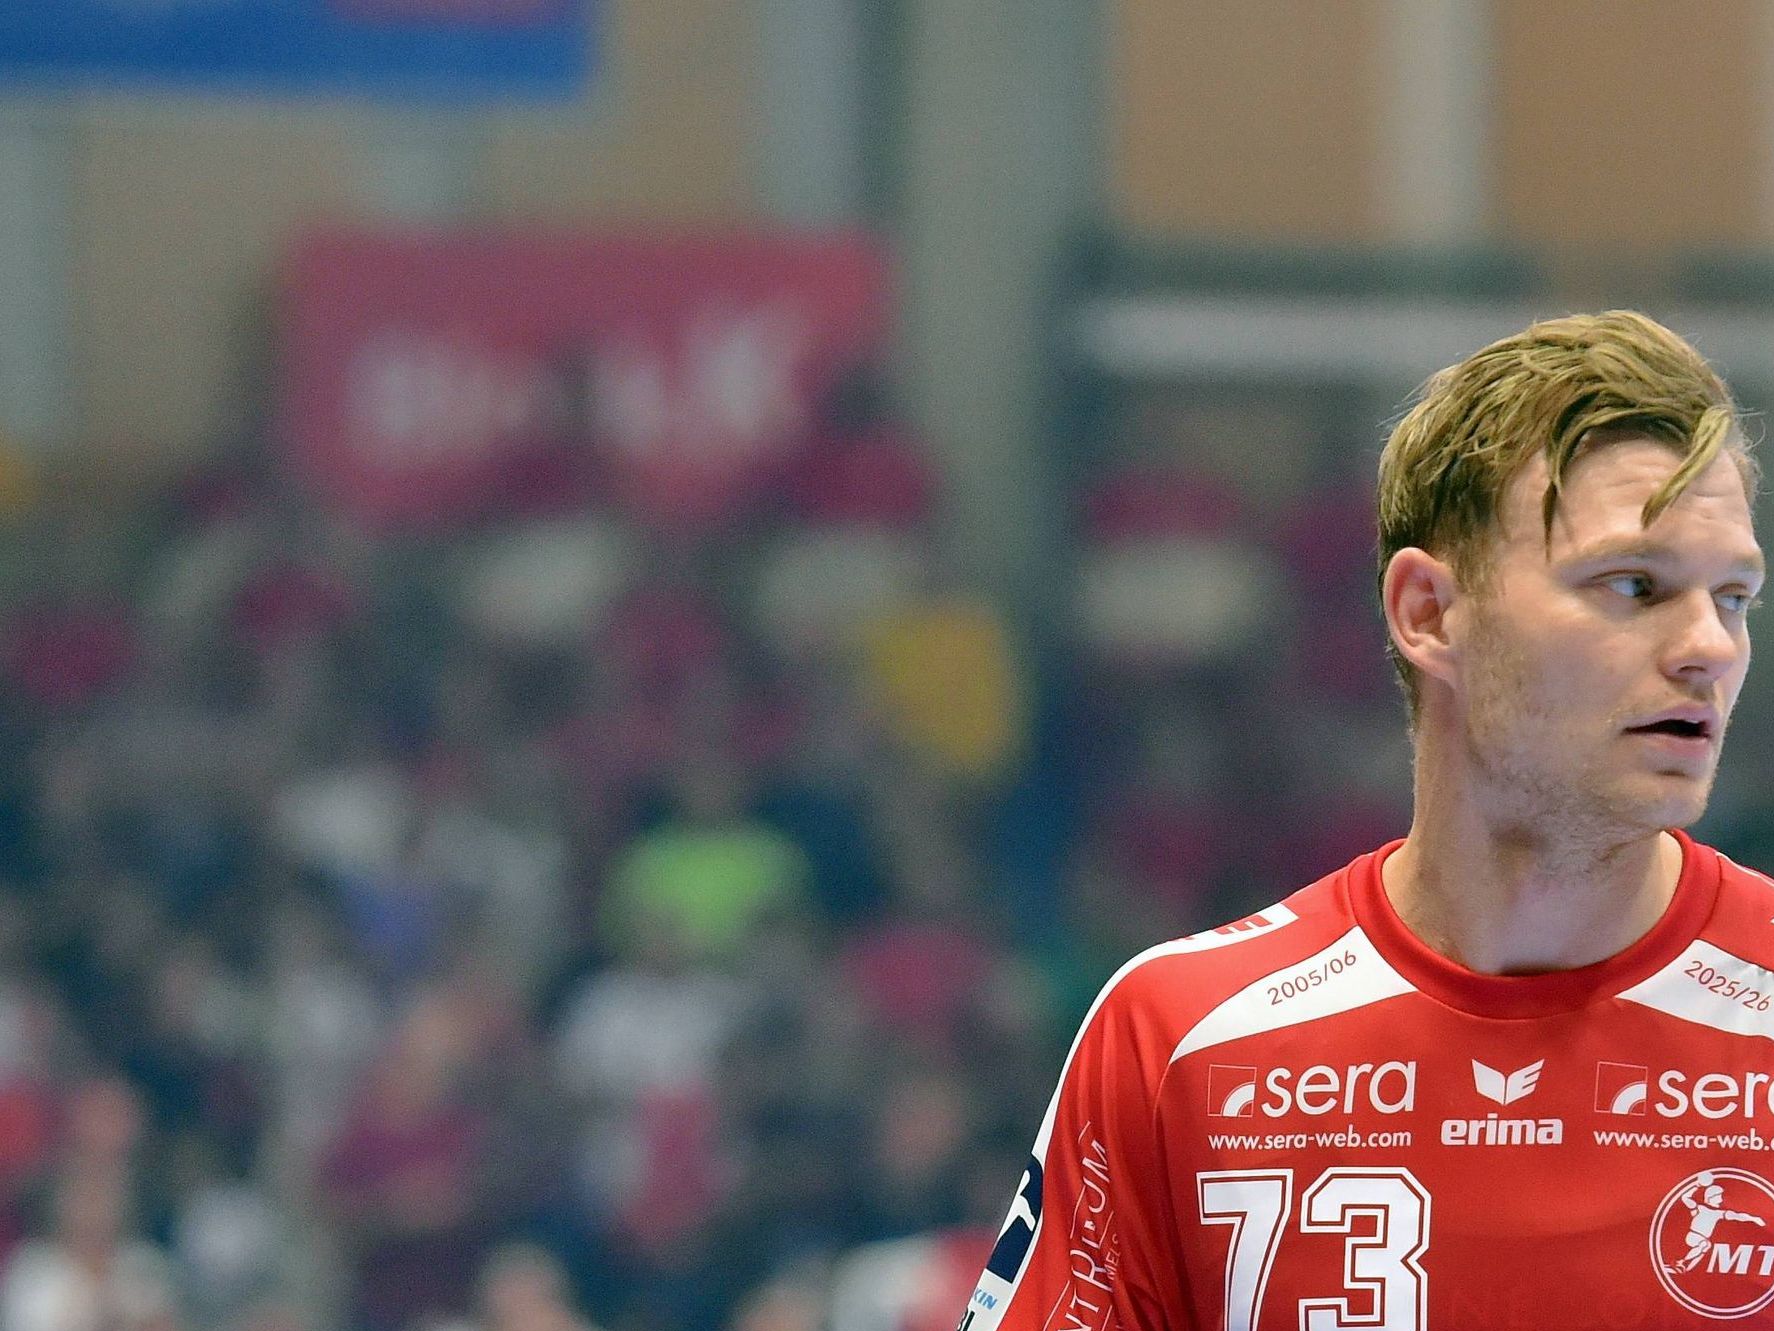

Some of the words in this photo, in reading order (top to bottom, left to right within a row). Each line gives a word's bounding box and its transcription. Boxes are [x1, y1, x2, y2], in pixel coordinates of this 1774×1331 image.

[1266, 949, 1358, 1006] 2005/06
[1683, 960, 1772, 1013] 2025/26
[1261, 1060, 1417, 1118] sera
[1207, 1123, 1412, 1150] www.sera-web.com
[1440, 1113, 1564, 1146] erima
